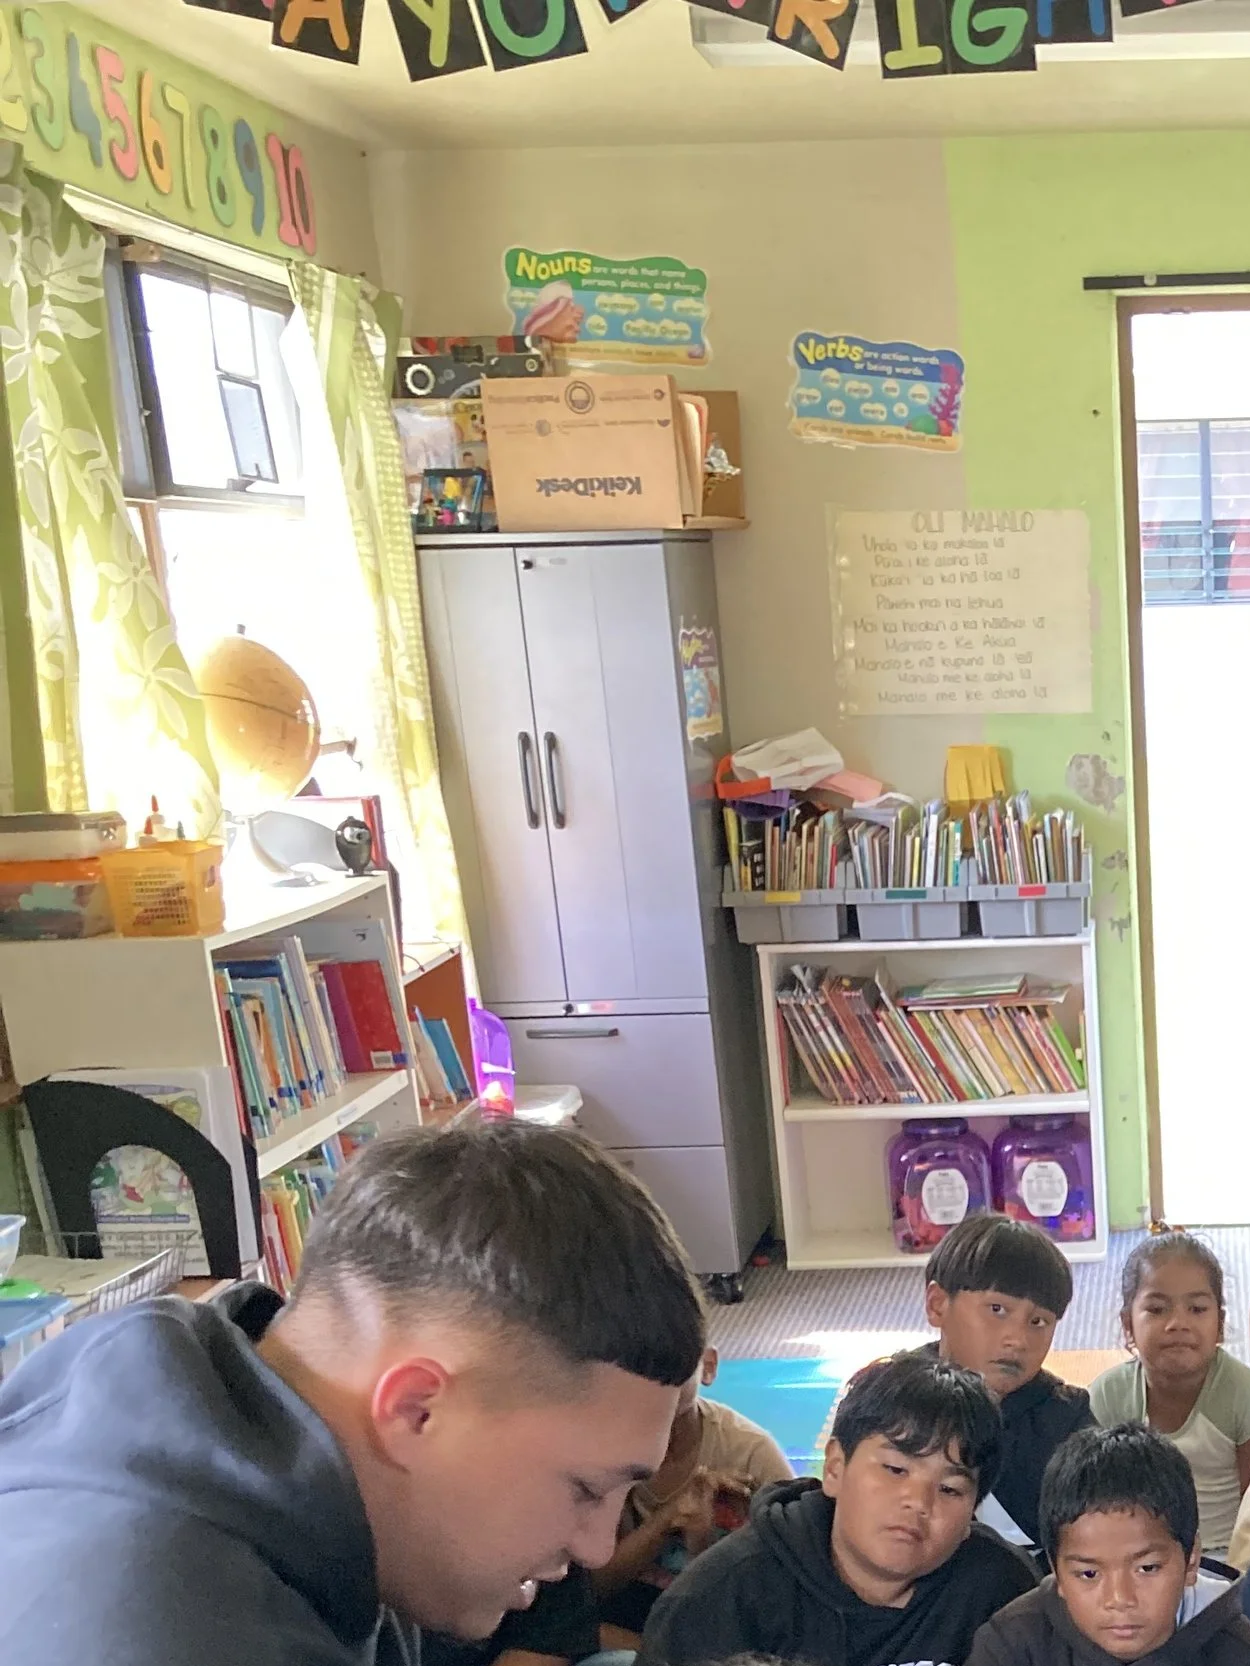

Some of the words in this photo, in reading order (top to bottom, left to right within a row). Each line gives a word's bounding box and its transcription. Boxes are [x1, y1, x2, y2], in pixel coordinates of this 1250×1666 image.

[95, 46, 139, 181] 5
[139, 69, 171, 195] 6
[202, 104, 236, 227] 8
[234, 118, 265, 236] 9
[266, 132, 316, 256] 10
[516, 252, 592, 280] Nouns
[798, 338, 864, 364] Verbs
[881, 352, 909, 361] action
[912, 356, 940, 365] words
[867, 362, 892, 374] being
[536, 476, 642, 497] KeikiDesk
[911, 511, 945, 533] OLI
[962, 511, 1034, 533] MAHALO
